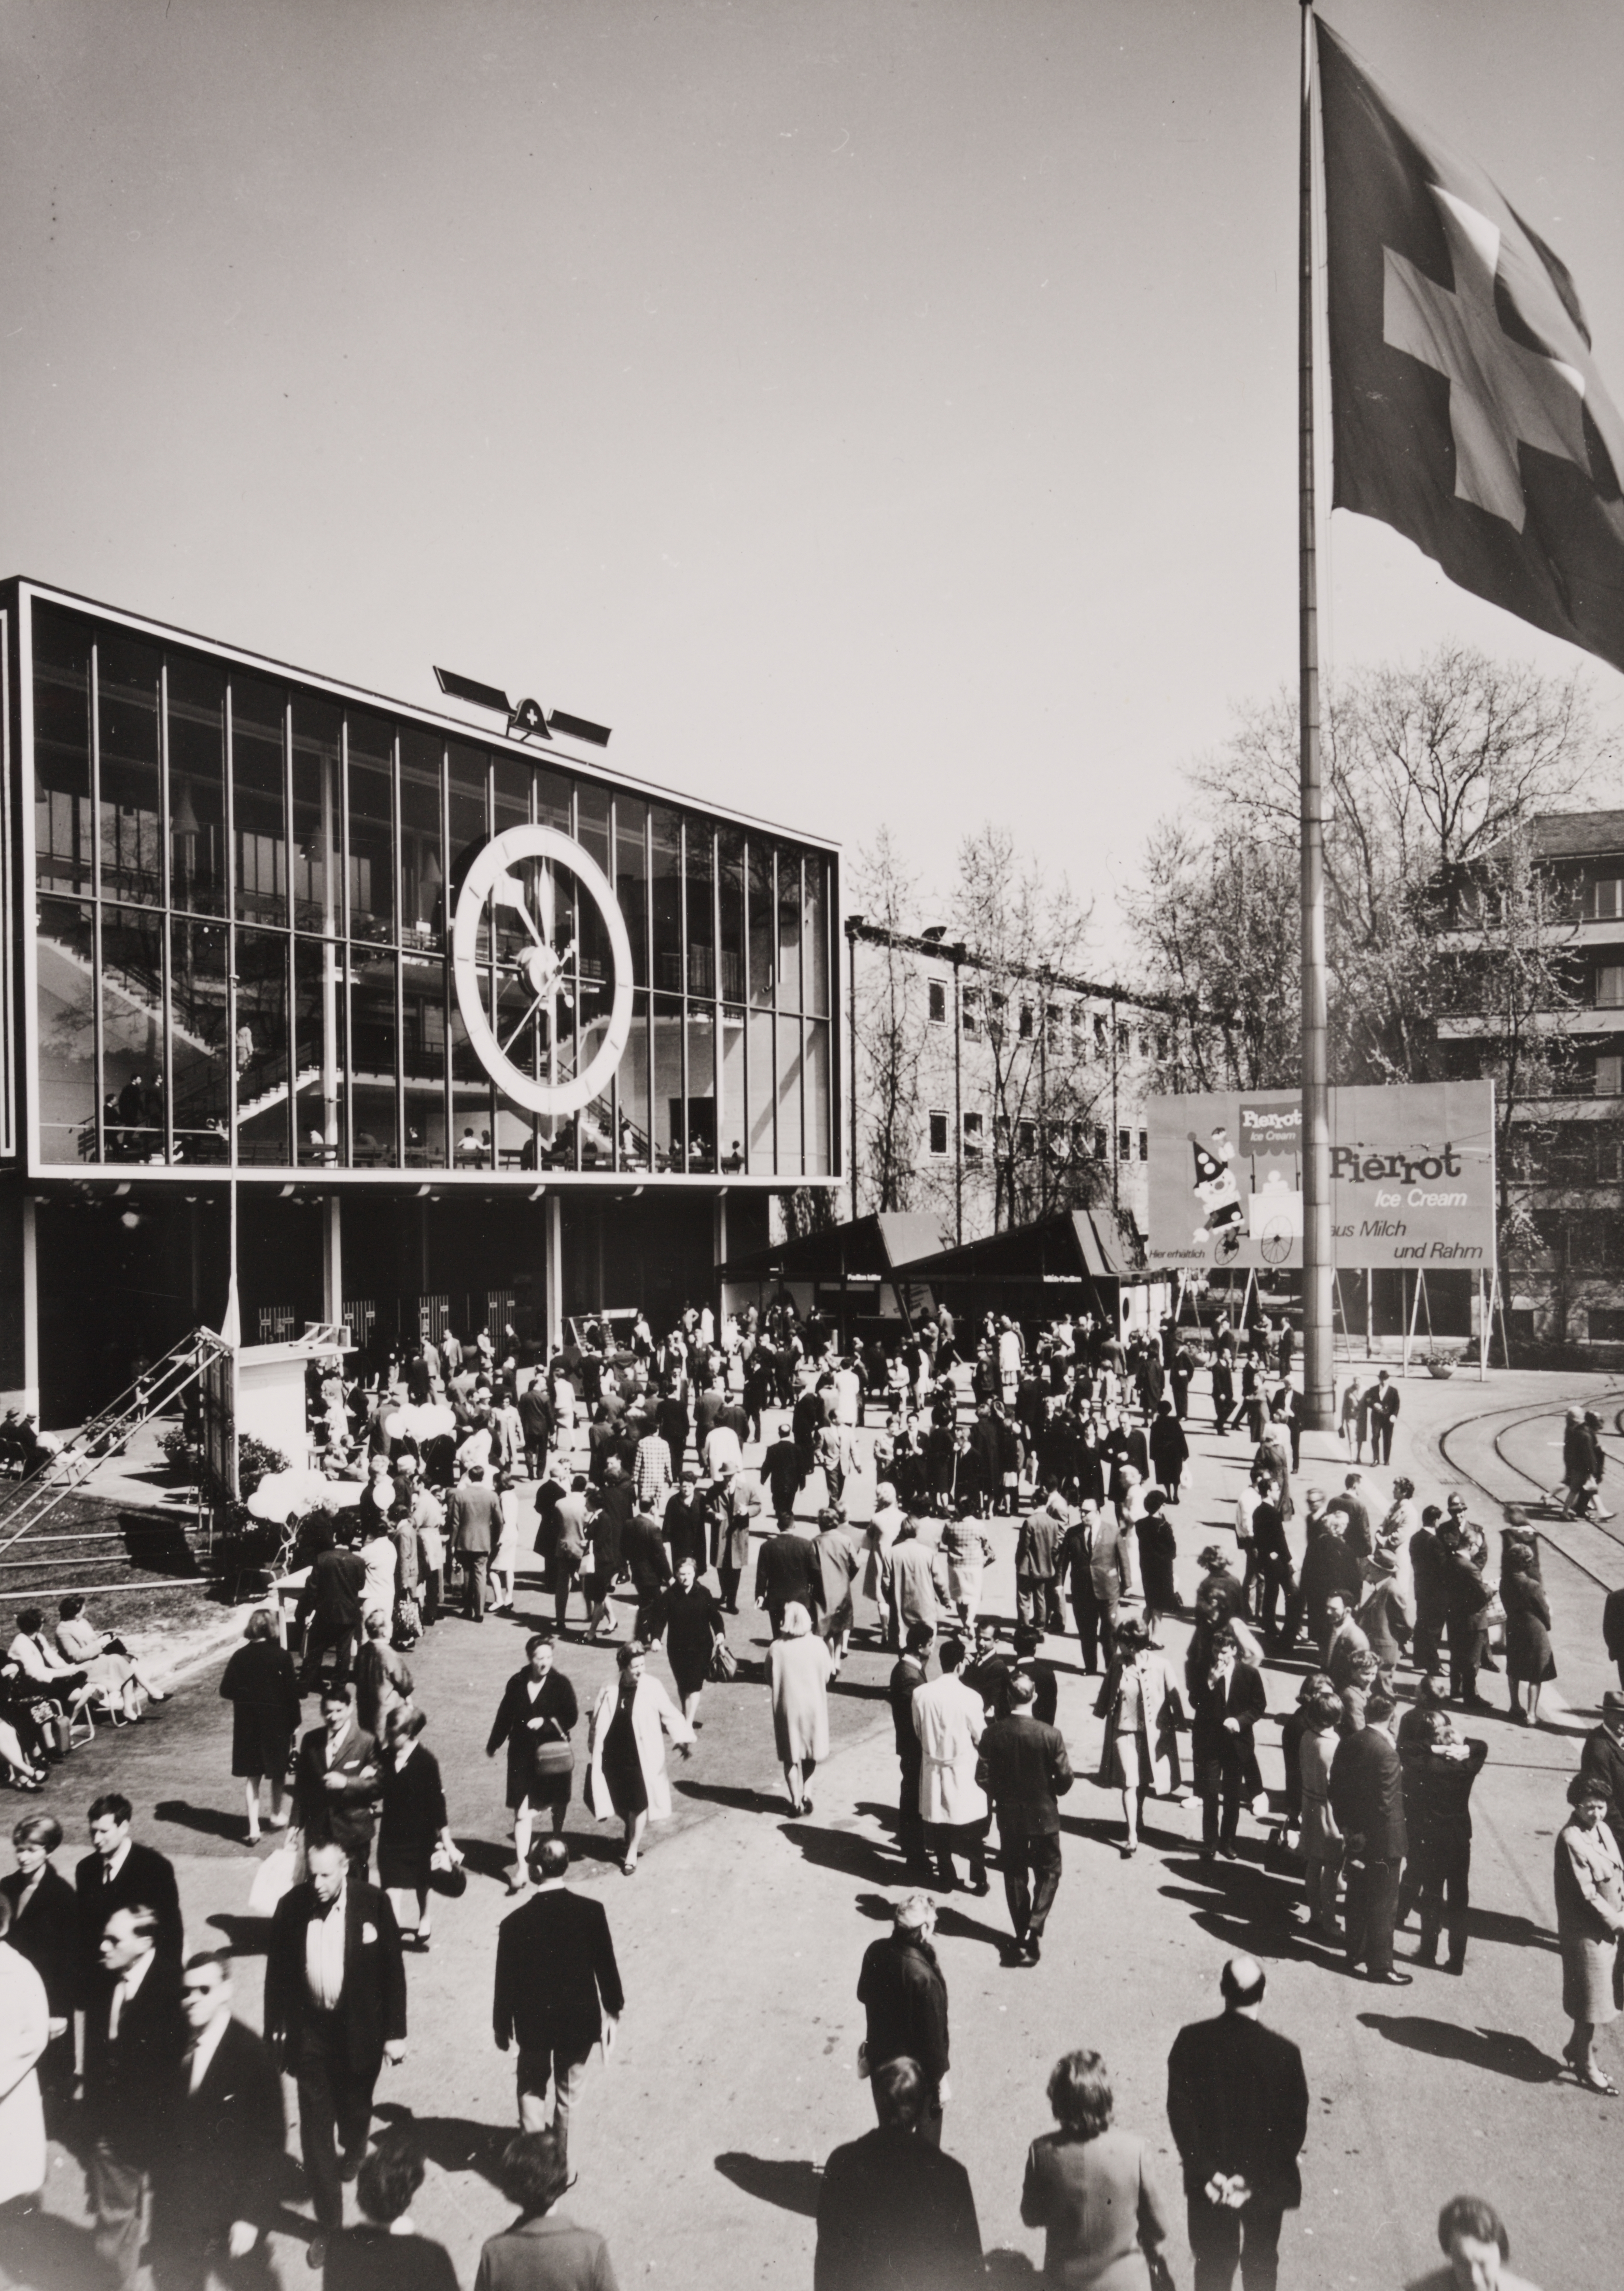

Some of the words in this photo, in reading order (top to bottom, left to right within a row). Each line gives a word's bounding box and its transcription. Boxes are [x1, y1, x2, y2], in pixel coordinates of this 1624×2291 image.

[1242, 1109, 1302, 1129] Pierrot
[1250, 1131, 1264, 1141] Ice
[1266, 1130, 1296, 1140] Cream
[1329, 1142, 1461, 1184] Pierrot
[1375, 1190, 1401, 1207] Ice
[1407, 1188, 1467, 1207] Cream
[1331, 1225, 1354, 1237] aus
[1360, 1220, 1407, 1236] Milch
[1149, 1250, 1166, 1258] Hier
[1167, 1249, 1205, 1258] erhältlich
[1394, 1242, 1427, 1258] und
[1430, 1242, 1483, 1258] Rahm
